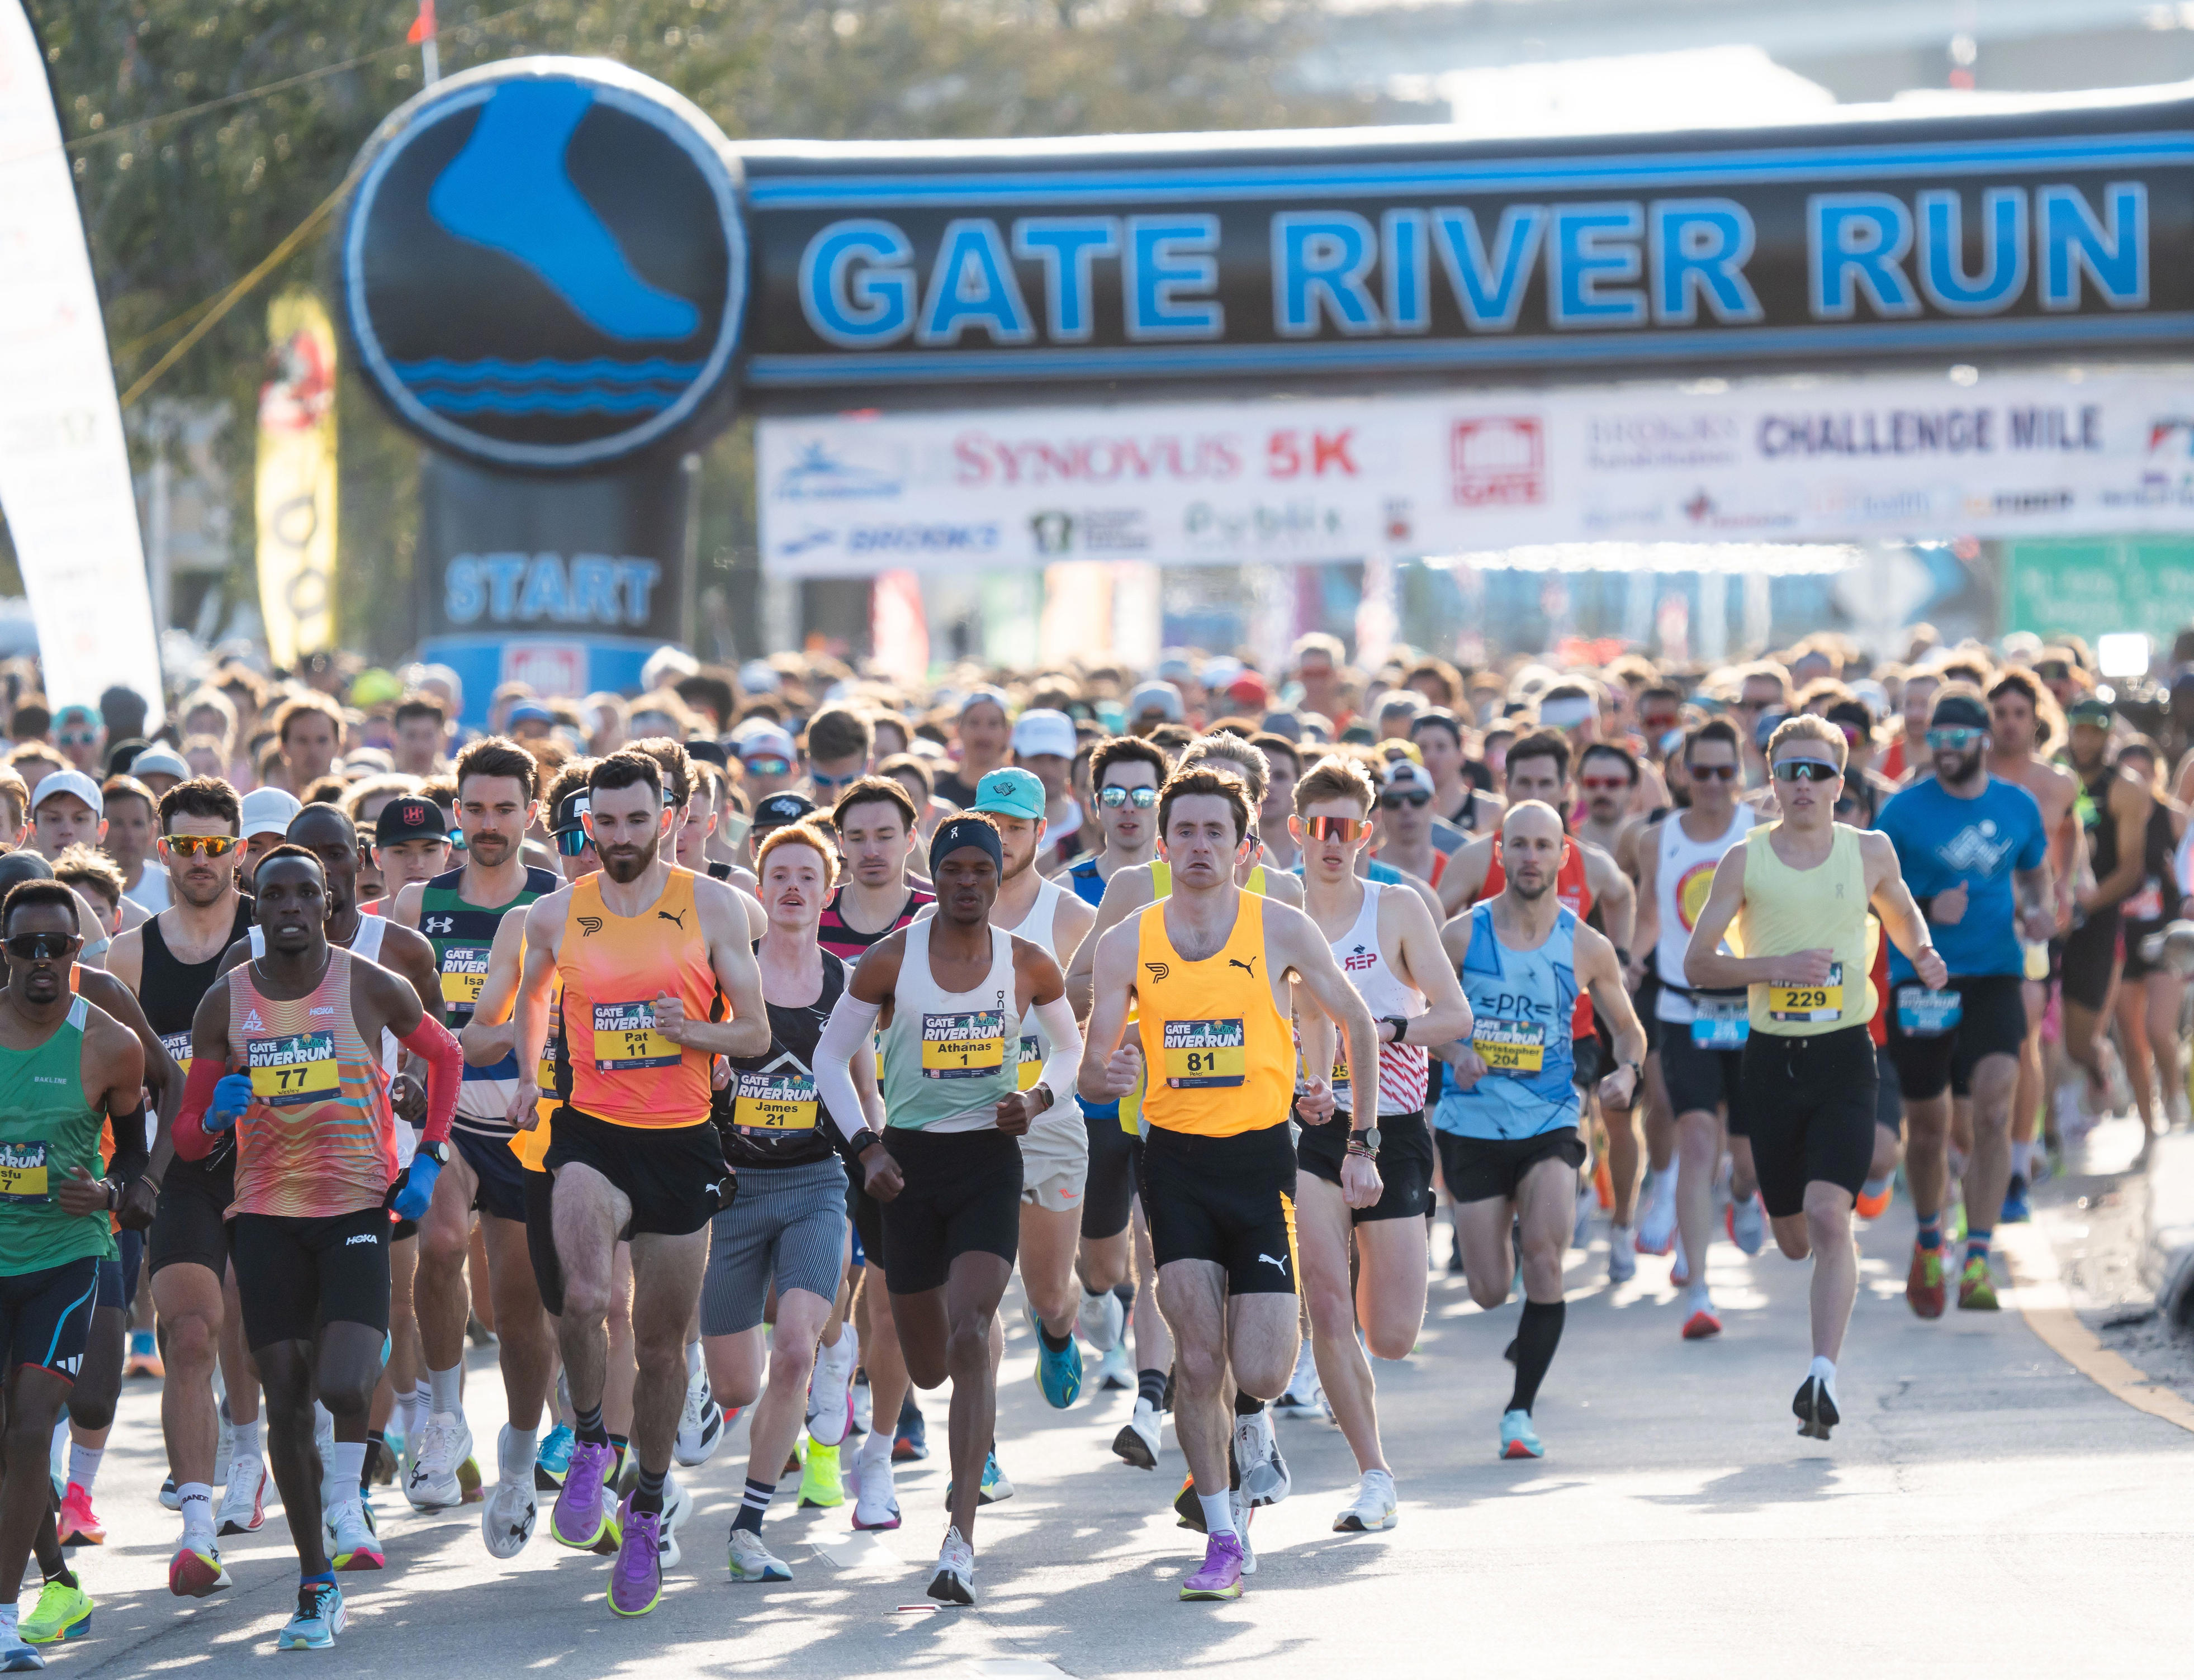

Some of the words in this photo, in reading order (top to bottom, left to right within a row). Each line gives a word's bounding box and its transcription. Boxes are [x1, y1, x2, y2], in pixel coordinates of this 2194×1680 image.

[798, 214, 1225, 349] GATE
[1270, 198, 1764, 335] RIVER
[1807, 181, 2150, 320] RUN
[1758, 407, 1998, 459] CHALLENGE
[2011, 404, 2104, 451] MILE
[954, 429, 1242, 486] SYNOVUS
[1268, 428, 1359, 480] 5K
[444, 551, 660, 624] START
[446, 950, 473, 960] GATE
[442, 960, 487, 974] RIVER
[465, 975, 484, 985] Isa
[1786, 991, 1827, 1007] 229
[309, 1007, 334, 1015] HOKA
[595, 1007, 623, 1017] GATE
[594, 1017, 638, 1031] RIVER
[926, 1017, 955, 1028] GATE
[1165, 1024, 1191, 1034] GATE
[1475, 1018, 1501, 1030] GATE
[625, 1032, 648, 1042] Pat
[924, 1027, 969, 1041] RIVER
[970, 1026, 1000, 1040] RUN
[1473, 1029, 1513, 1043] RIVER
[1513, 1033, 1543, 1046] RUN
[162, 1036, 188, 1049] GATE
[249, 1042, 278, 1053] GATE
[1164, 1034, 1205, 1048] RIVER
[1206, 1034, 1238, 1047] RUN
[170, 1045, 193, 1060] IVE
[627, 1043, 646, 1056] 11
[937, 1043, 991, 1053] Athanas
[1474, 1042, 1540, 1055] Christopher
[249, 1051, 294, 1067] RIVER
[296, 1047, 330, 1063] RUN
[960, 1053, 968, 1066] 1
[1187, 1052, 1214, 1071] 81
[1492, 1052, 1519, 1066] 204
[1332, 1065, 1348, 1077] 25
[34, 1076, 67, 1085] BAKLINE
[276, 1067, 307, 1089] 77
[741, 1075, 770, 1086] GATE
[738, 1084, 783, 1100] RIVER
[783, 1089, 815, 1102] RUN
[755, 1102, 798, 1113] James
[765, 1113, 784, 1126] 21
[8, 1155, 42, 1168] RUN
[0, 1170, 21, 1179] sfu
[2, 1179, 12, 1190] 7
[345, 1233, 378, 1246] HOKA
[182, 1494, 210, 1505] BANDIT
